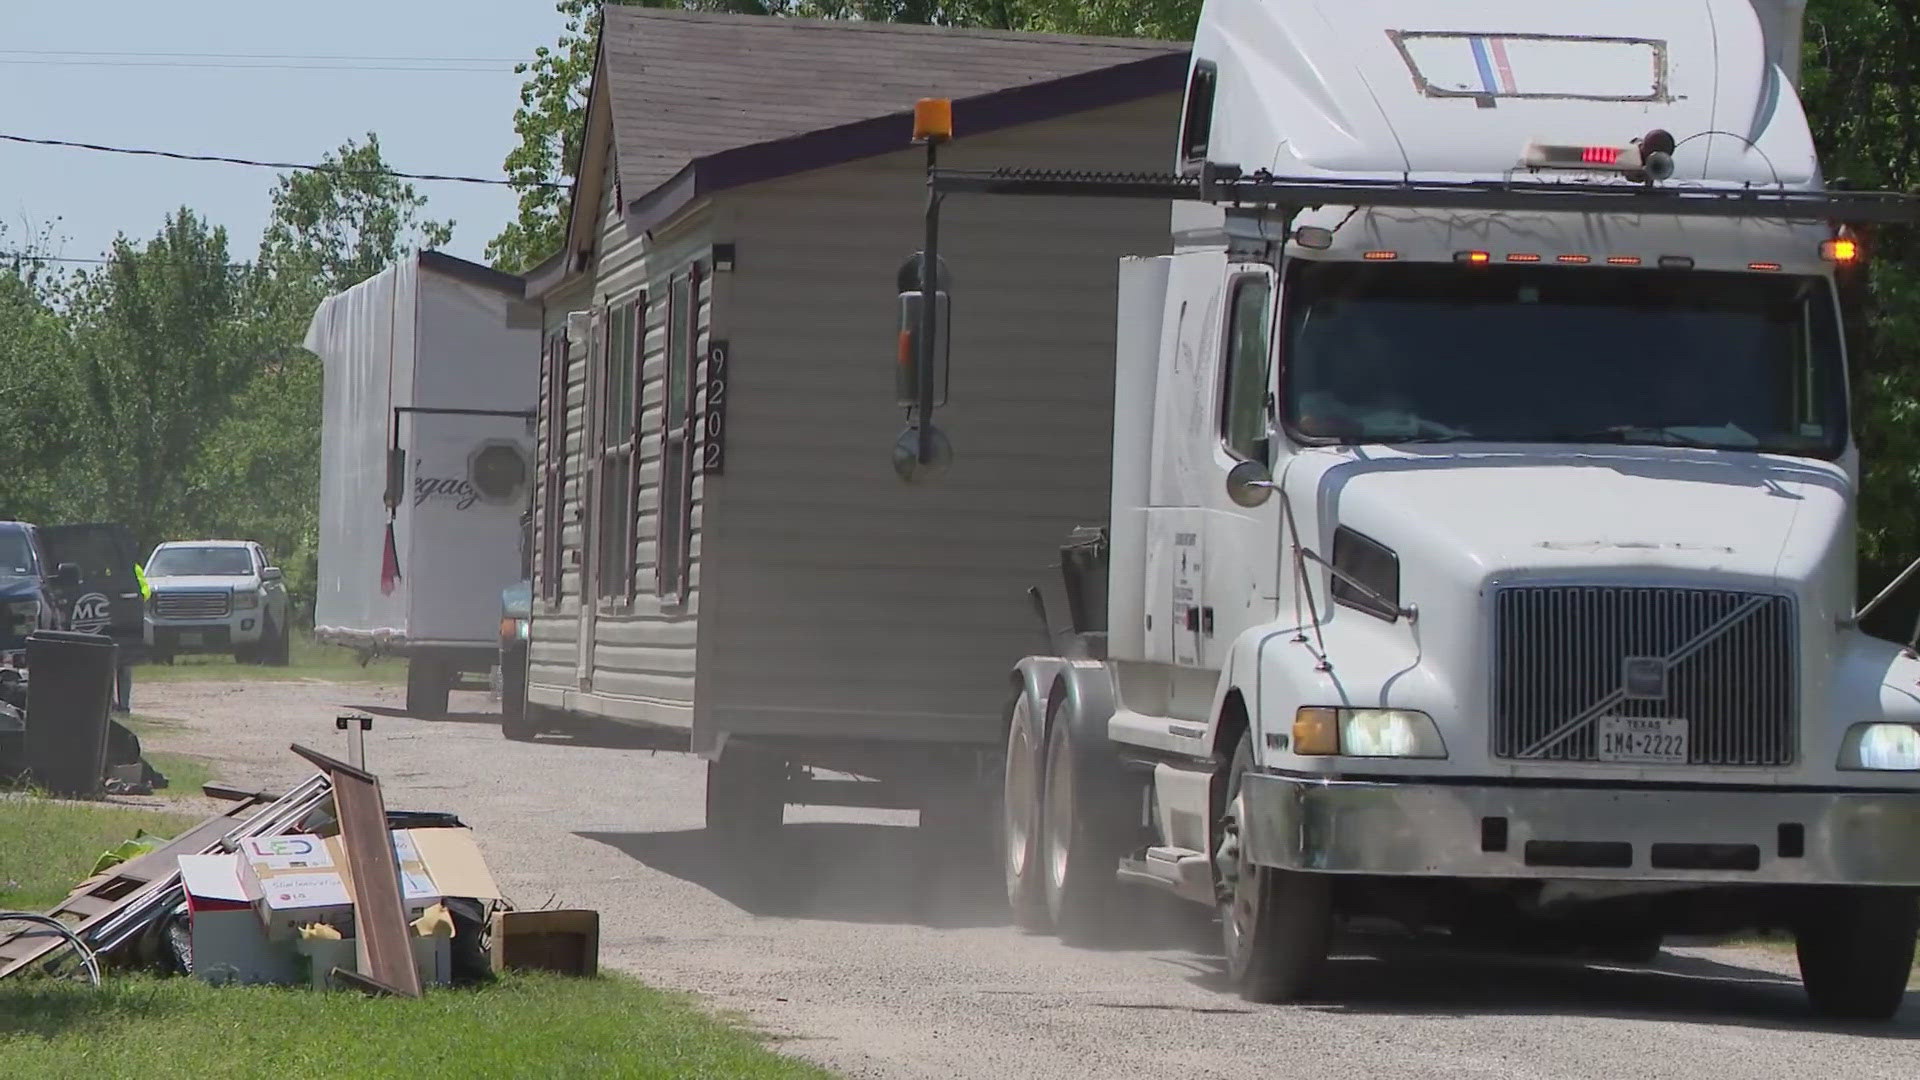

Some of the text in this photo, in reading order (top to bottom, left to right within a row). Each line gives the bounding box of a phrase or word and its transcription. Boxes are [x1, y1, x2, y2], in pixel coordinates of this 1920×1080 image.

[706, 348, 723, 468] 9202
[72, 602, 110, 620] MC
[1627, 720, 1660, 729] TEXAS
[252, 840, 312, 856] LED
